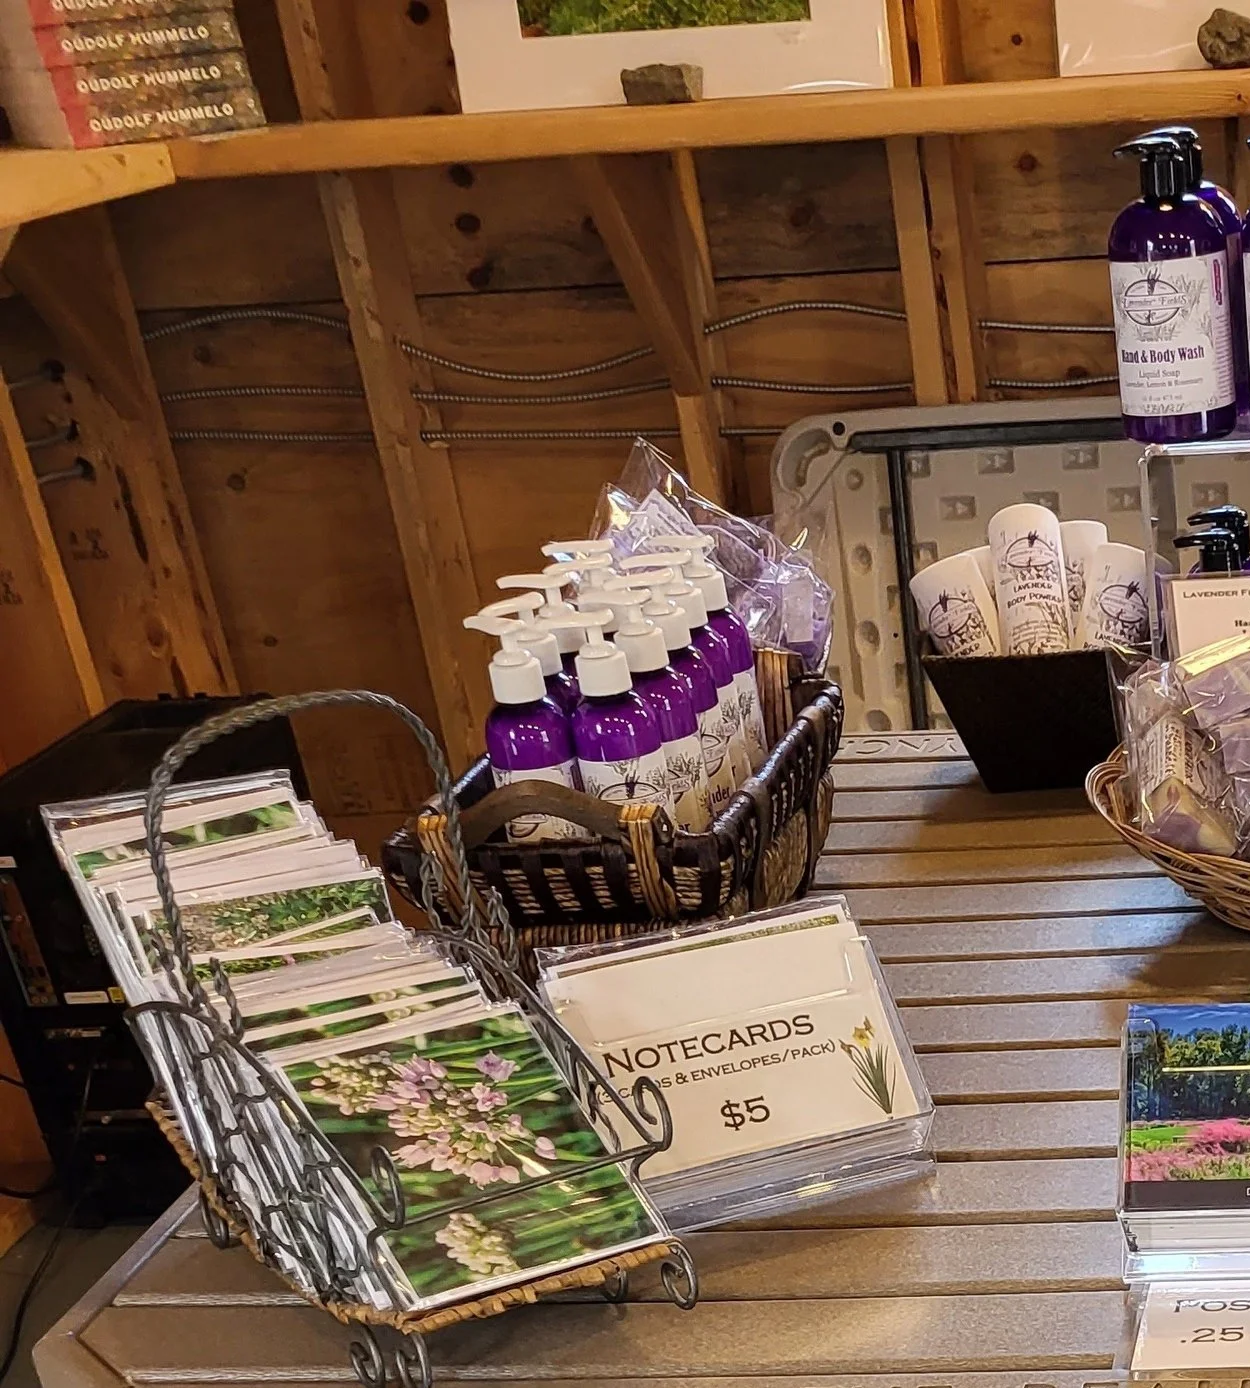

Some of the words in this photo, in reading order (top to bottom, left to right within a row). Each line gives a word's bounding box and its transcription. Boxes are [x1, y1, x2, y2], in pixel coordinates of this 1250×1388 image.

[61, 34, 125, 53] OUDOLF
[130, 25, 209, 46] HUMMELO
[76, 73, 140, 94] OUDOLF
[145, 64, 221, 85] HUMMELO
[89, 113, 152, 132] OUDOLF
[156, 103, 234, 123] HUMMELO
[1141, 350, 1148, 363] &
[1149, 349, 1176, 364] Body
[1178, 345, 1205, 361] Wash
[1183, 590, 1238, 599] LAVENDER
[602, 1013, 815, 1079] NOTECARDS
[675, 1072, 689, 1085] &
[691, 1038, 836, 1082] ENVELOPES/PACK)
[720, 1096, 771, 1131] $5
[1180, 1326, 1244, 1344] .25
